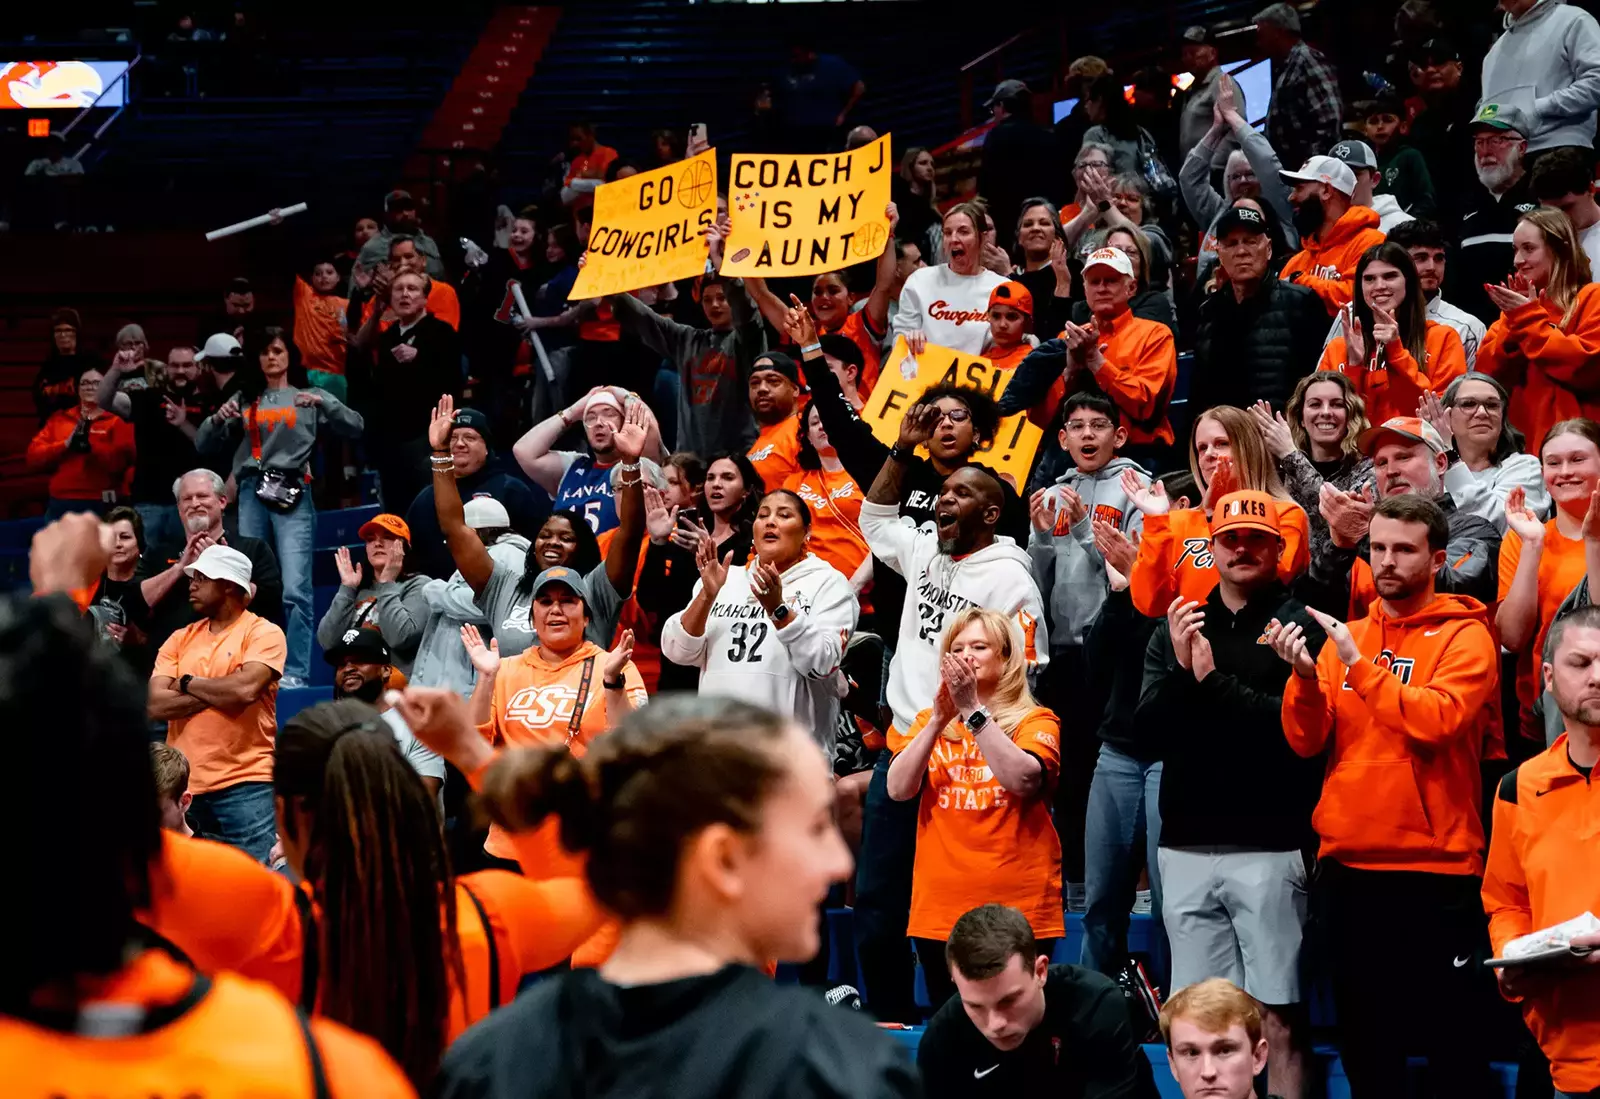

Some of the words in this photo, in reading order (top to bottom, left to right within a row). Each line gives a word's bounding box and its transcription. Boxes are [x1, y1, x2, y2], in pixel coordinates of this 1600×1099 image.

[734, 154, 852, 188] COACH
[868, 141, 884, 174] J
[639, 175, 674, 211] GO
[759, 200, 793, 229] IS
[818, 189, 865, 225] MY
[588, 208, 713, 259] COWGIRLS
[754, 232, 854, 267] AUNT
[928, 300, 991, 326] Cowgirl
[1223, 499, 1266, 518] POKES
[710, 602, 765, 619] KLAHOMA
[727, 622, 768, 663] 32
[938, 785, 1008, 811] STATE
